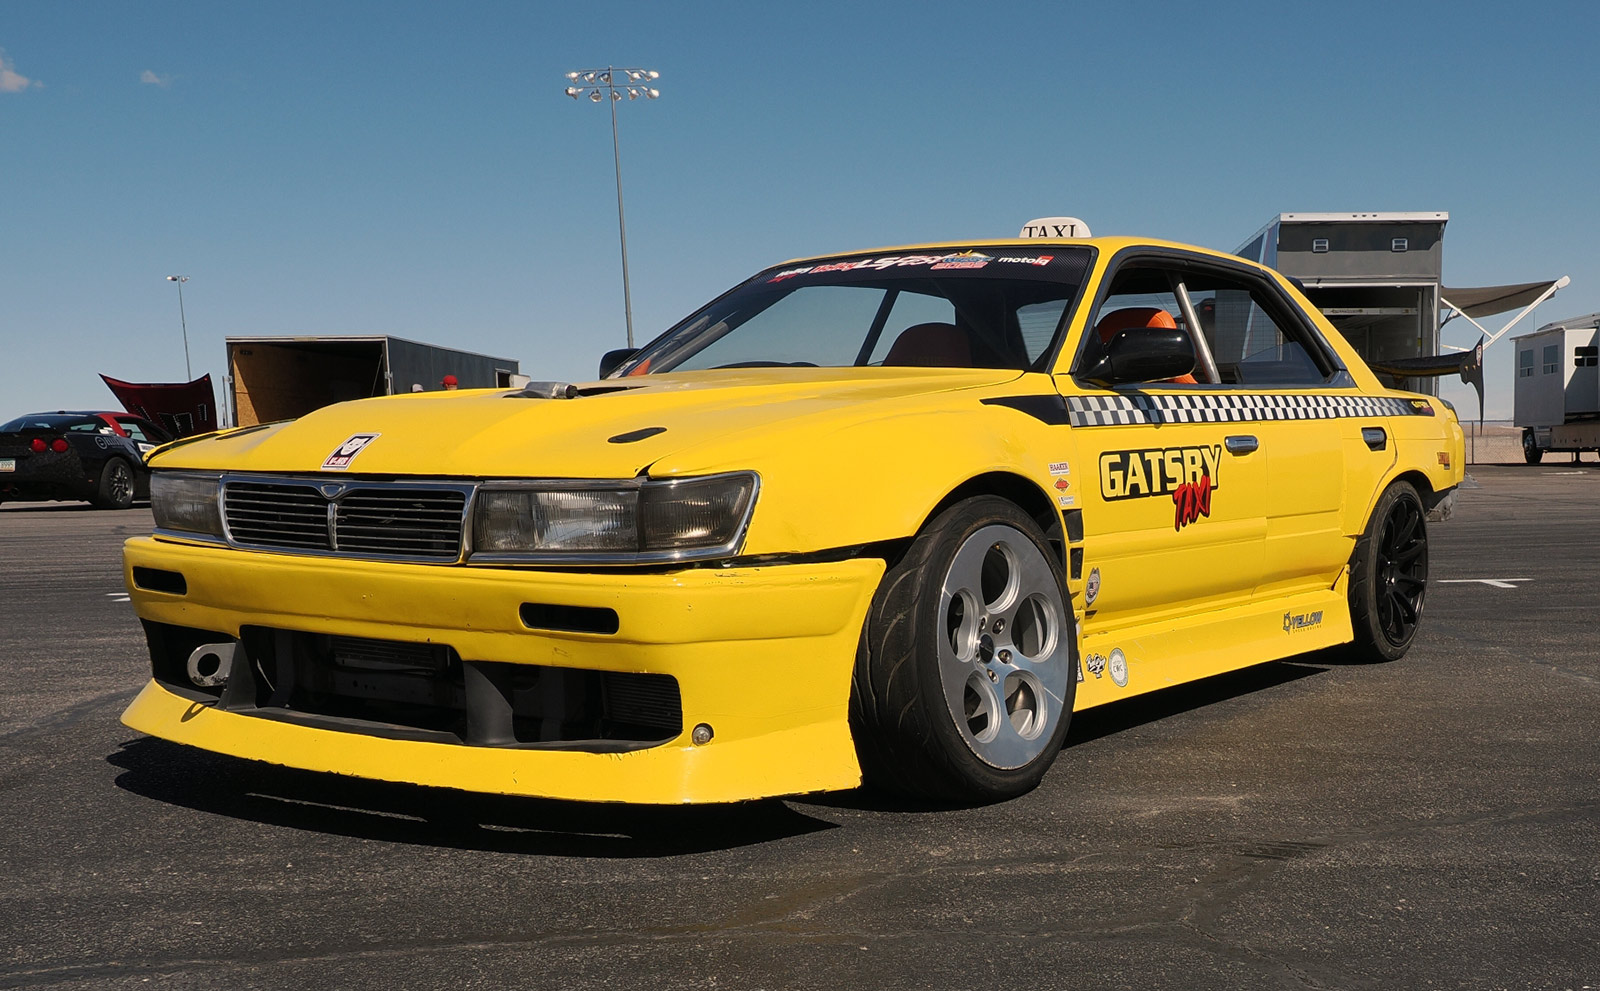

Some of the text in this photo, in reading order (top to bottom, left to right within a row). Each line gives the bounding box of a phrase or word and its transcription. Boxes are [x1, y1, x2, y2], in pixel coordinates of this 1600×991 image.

[1023, 224, 1076, 238] TAXI
[1099, 445, 1221, 501] GATSBY
[1173, 475, 1211, 532] TAXI
[1292, 611, 1323, 630] YELLOW
